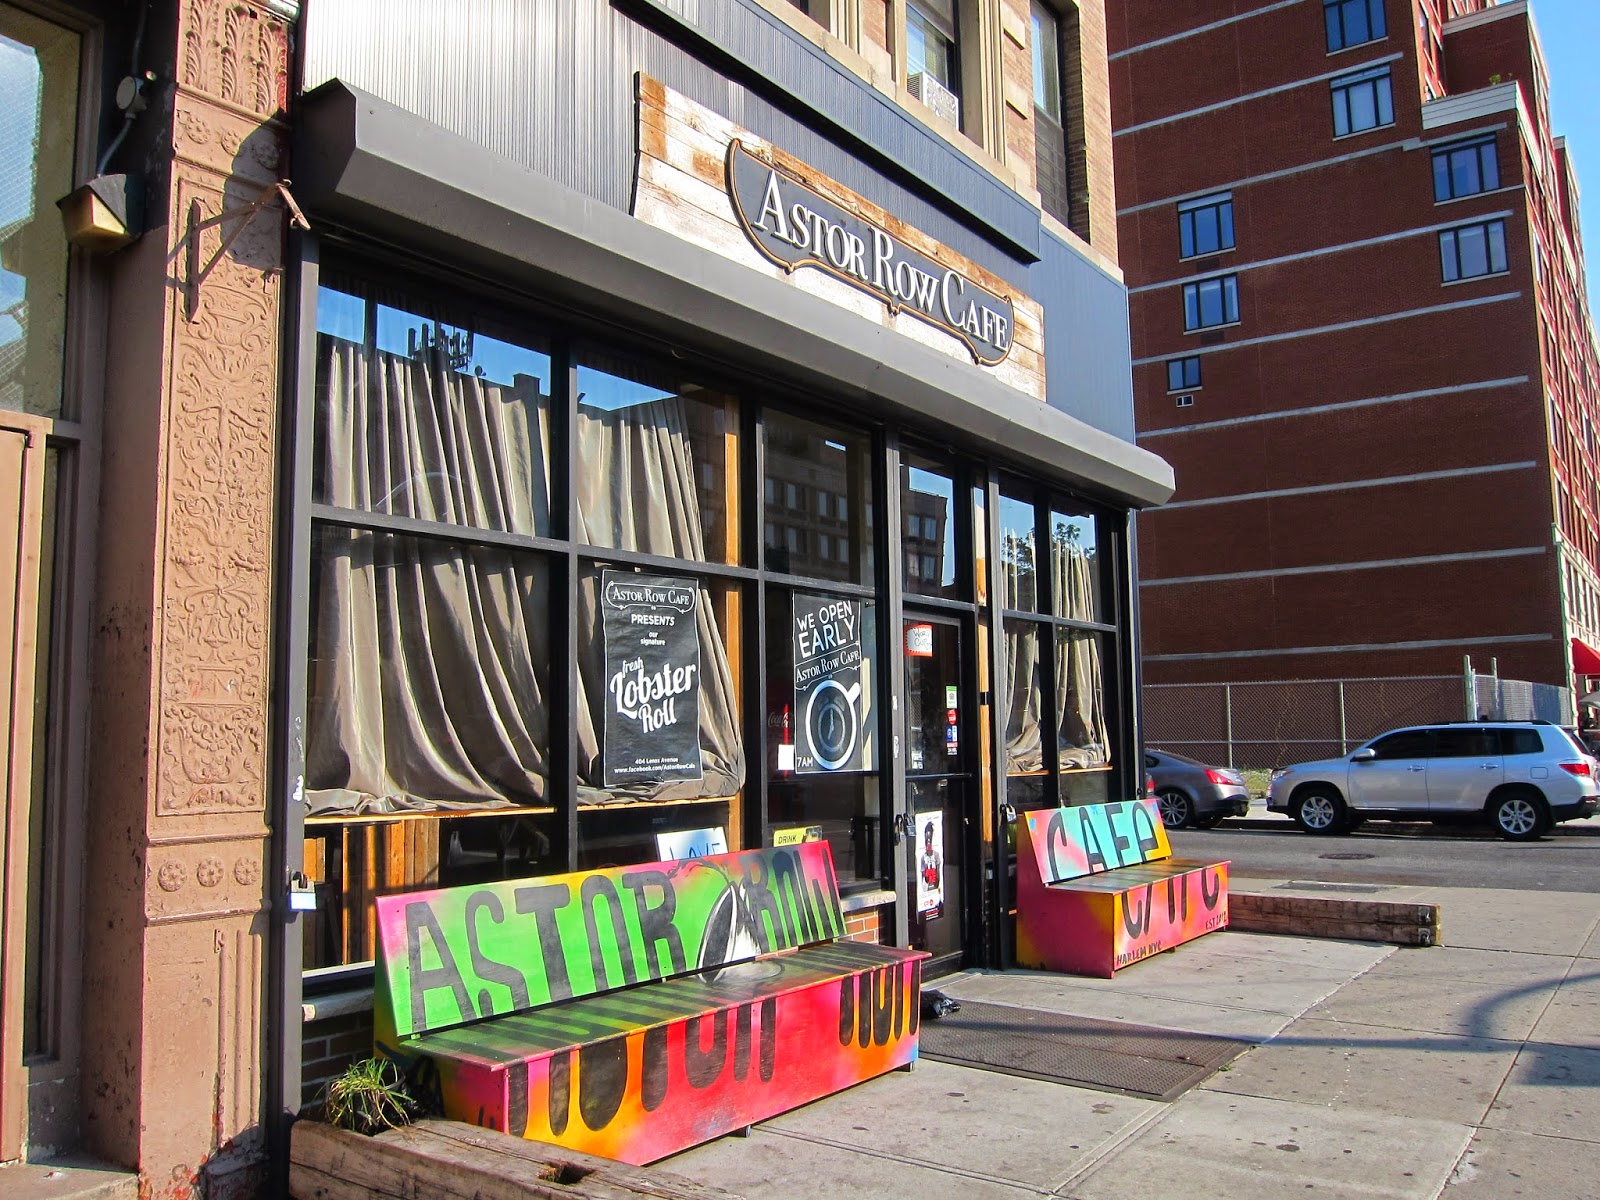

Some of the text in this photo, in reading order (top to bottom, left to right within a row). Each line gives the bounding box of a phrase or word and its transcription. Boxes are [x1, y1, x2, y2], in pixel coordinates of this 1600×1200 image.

[752, 169, 1010, 353] ASTOR ROW CAFE
[612, 586, 690, 605] ASTOR ROW CAFE
[631, 613, 675, 627] PRESENTS
[796, 600, 852, 632] WE OPEN
[640, 637, 666, 646] signature
[798, 615, 855, 659] EARLY
[622, 656, 644, 678] fresh
[796, 650, 860, 683] ASTOR ROW CAFE
[609, 662, 697, 720] Lobster
[638, 697, 677, 734] Roll
[797, 756, 813, 768] 7AM
[778, 834, 797, 845] DRINK
[1205, 917, 1215, 930] EST
[1116, 940, 1162, 966] HARLEM NYC
